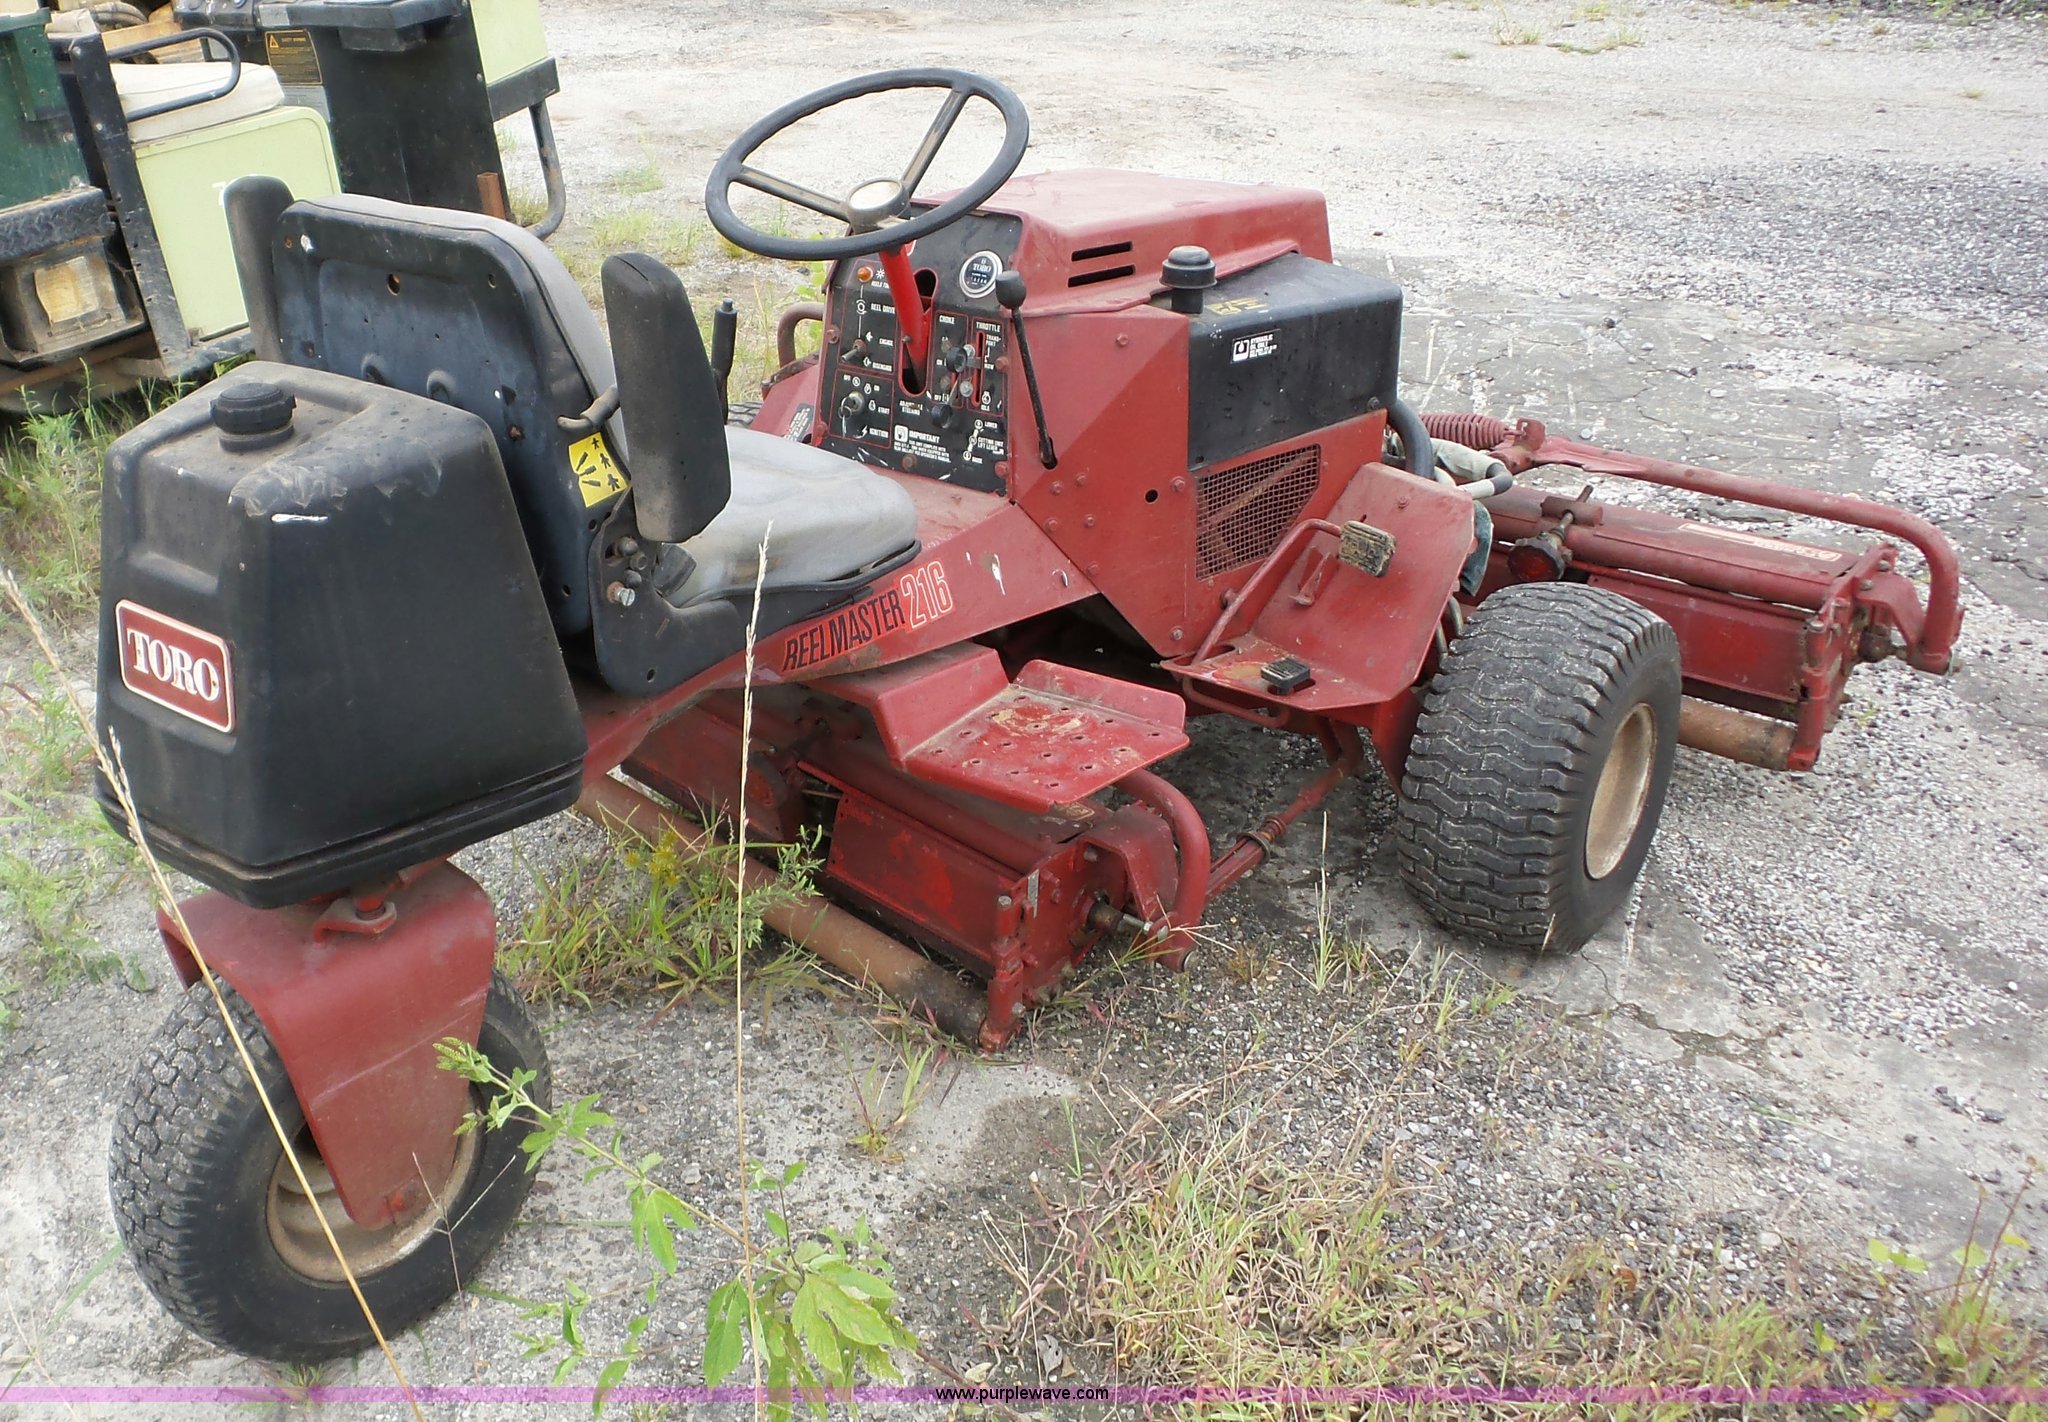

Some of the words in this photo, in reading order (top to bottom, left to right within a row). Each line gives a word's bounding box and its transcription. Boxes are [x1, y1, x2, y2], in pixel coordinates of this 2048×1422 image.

[976, 321, 1000, 332] THROTTLE
[877, 406, 890, 414] START
[909, 430, 940, 444] IMPORTANT
[782, 588, 906, 673] REELMASTER
[900, 560, 953, 629] 216
[126, 627, 220, 702] TORO
